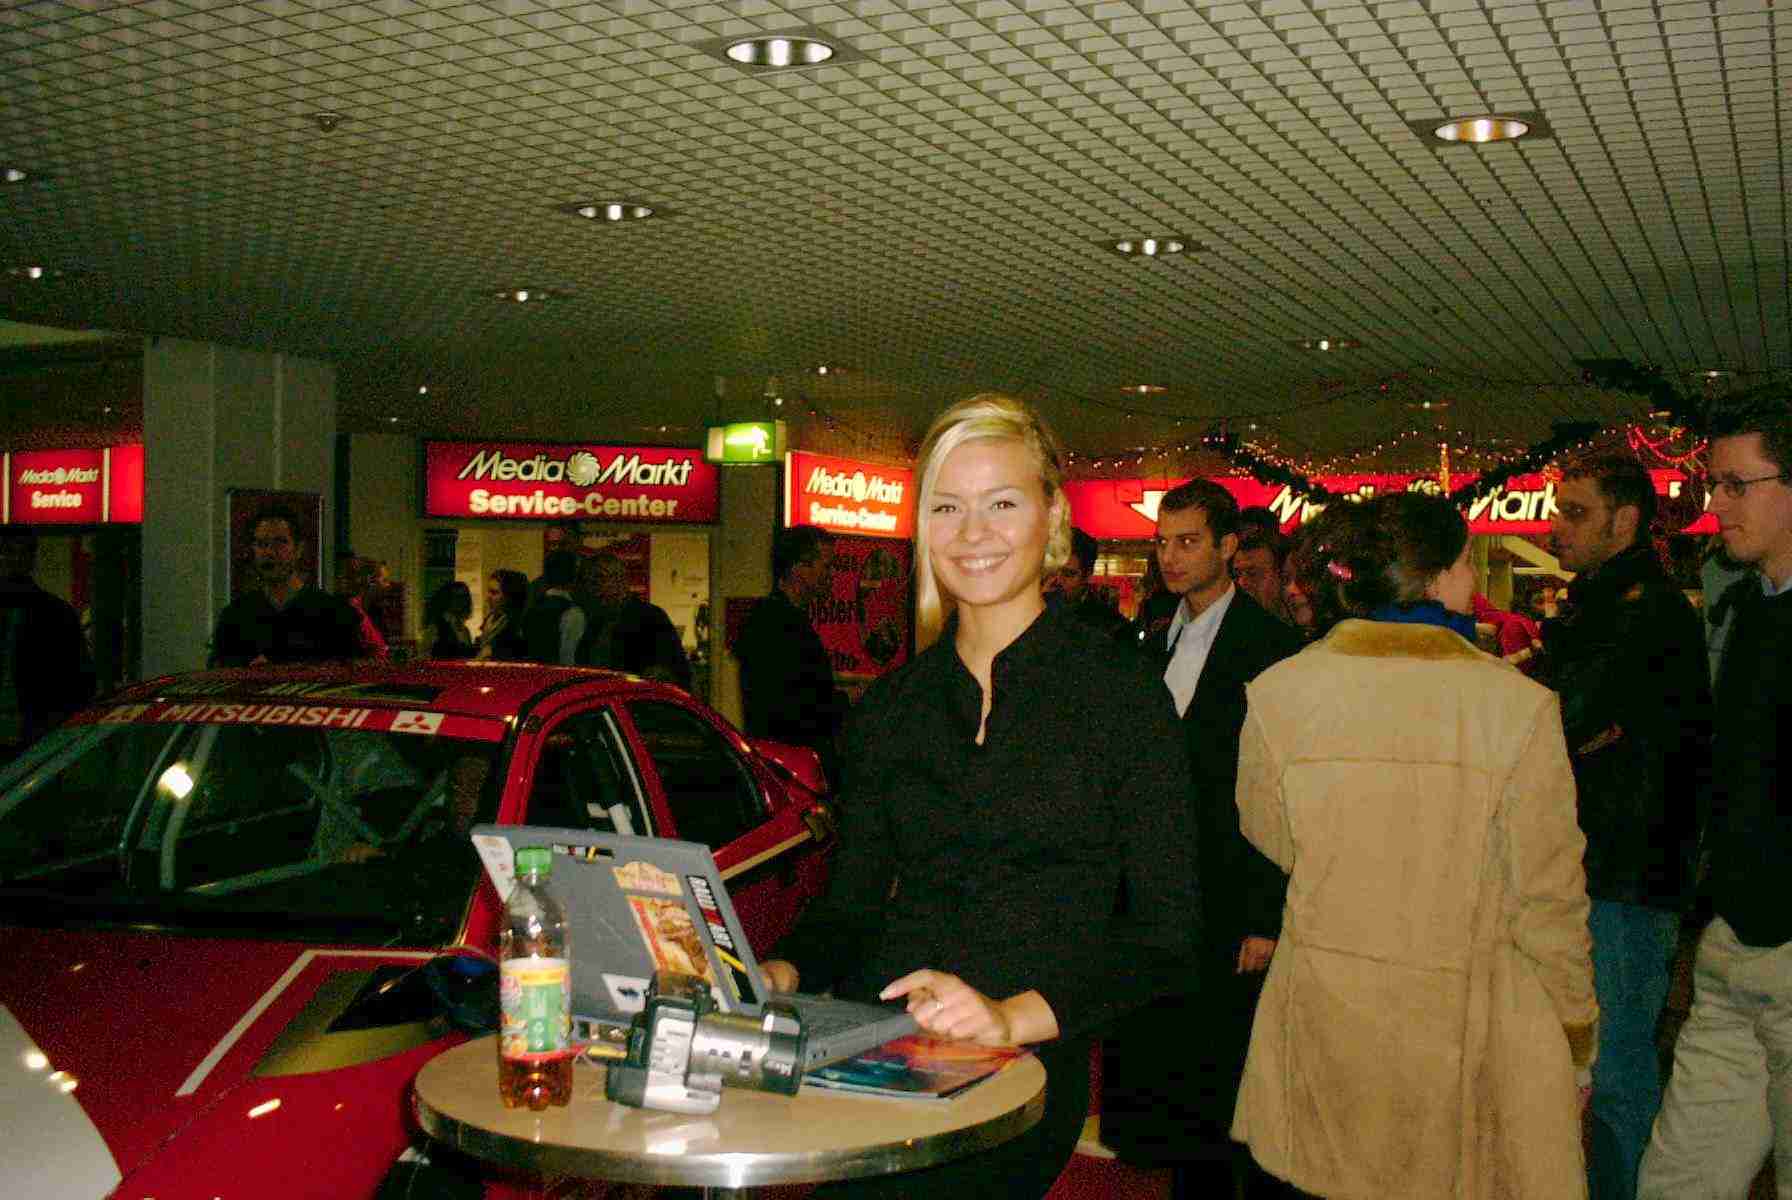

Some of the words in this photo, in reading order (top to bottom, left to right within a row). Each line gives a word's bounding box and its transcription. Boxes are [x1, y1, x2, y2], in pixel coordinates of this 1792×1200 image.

[457, 449, 566, 482] Media
[599, 453, 693, 485] Markt
[31, 489, 82, 509] Service
[468, 488, 679, 517] Service-Center
[159, 704, 370, 729] MITSUBISHI
